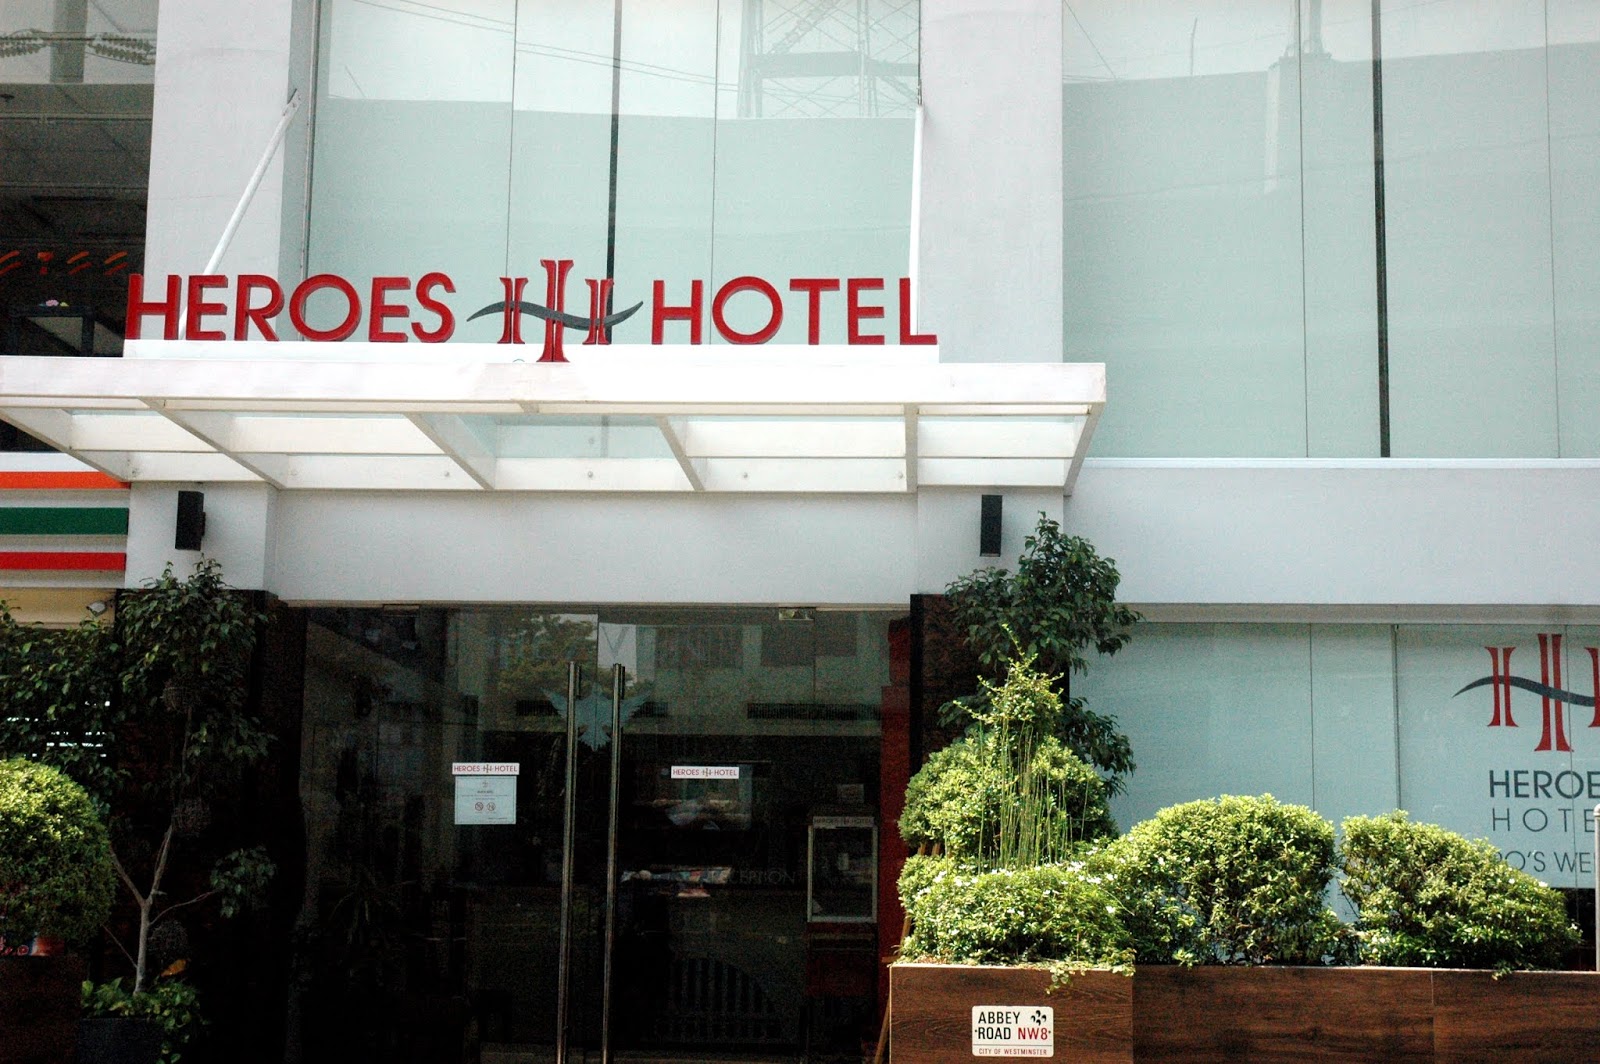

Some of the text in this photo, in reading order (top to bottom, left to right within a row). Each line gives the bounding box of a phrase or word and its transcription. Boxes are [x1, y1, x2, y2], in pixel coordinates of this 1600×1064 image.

[125, 272, 938, 346] HEROES HOTEL
[673, 768, 700, 776] HEROES
[1489, 769, 1600, 799] HEROE
[1492, 808, 1595, 833] HOTE
[1497, 850, 1596, 873] O'S WE
[978, 1011, 1021, 1024] ABBEY
[978, 1027, 1048, 1040] ROAD NW8
[1004, 1048, 1047, 1056] WESTMINSTER
